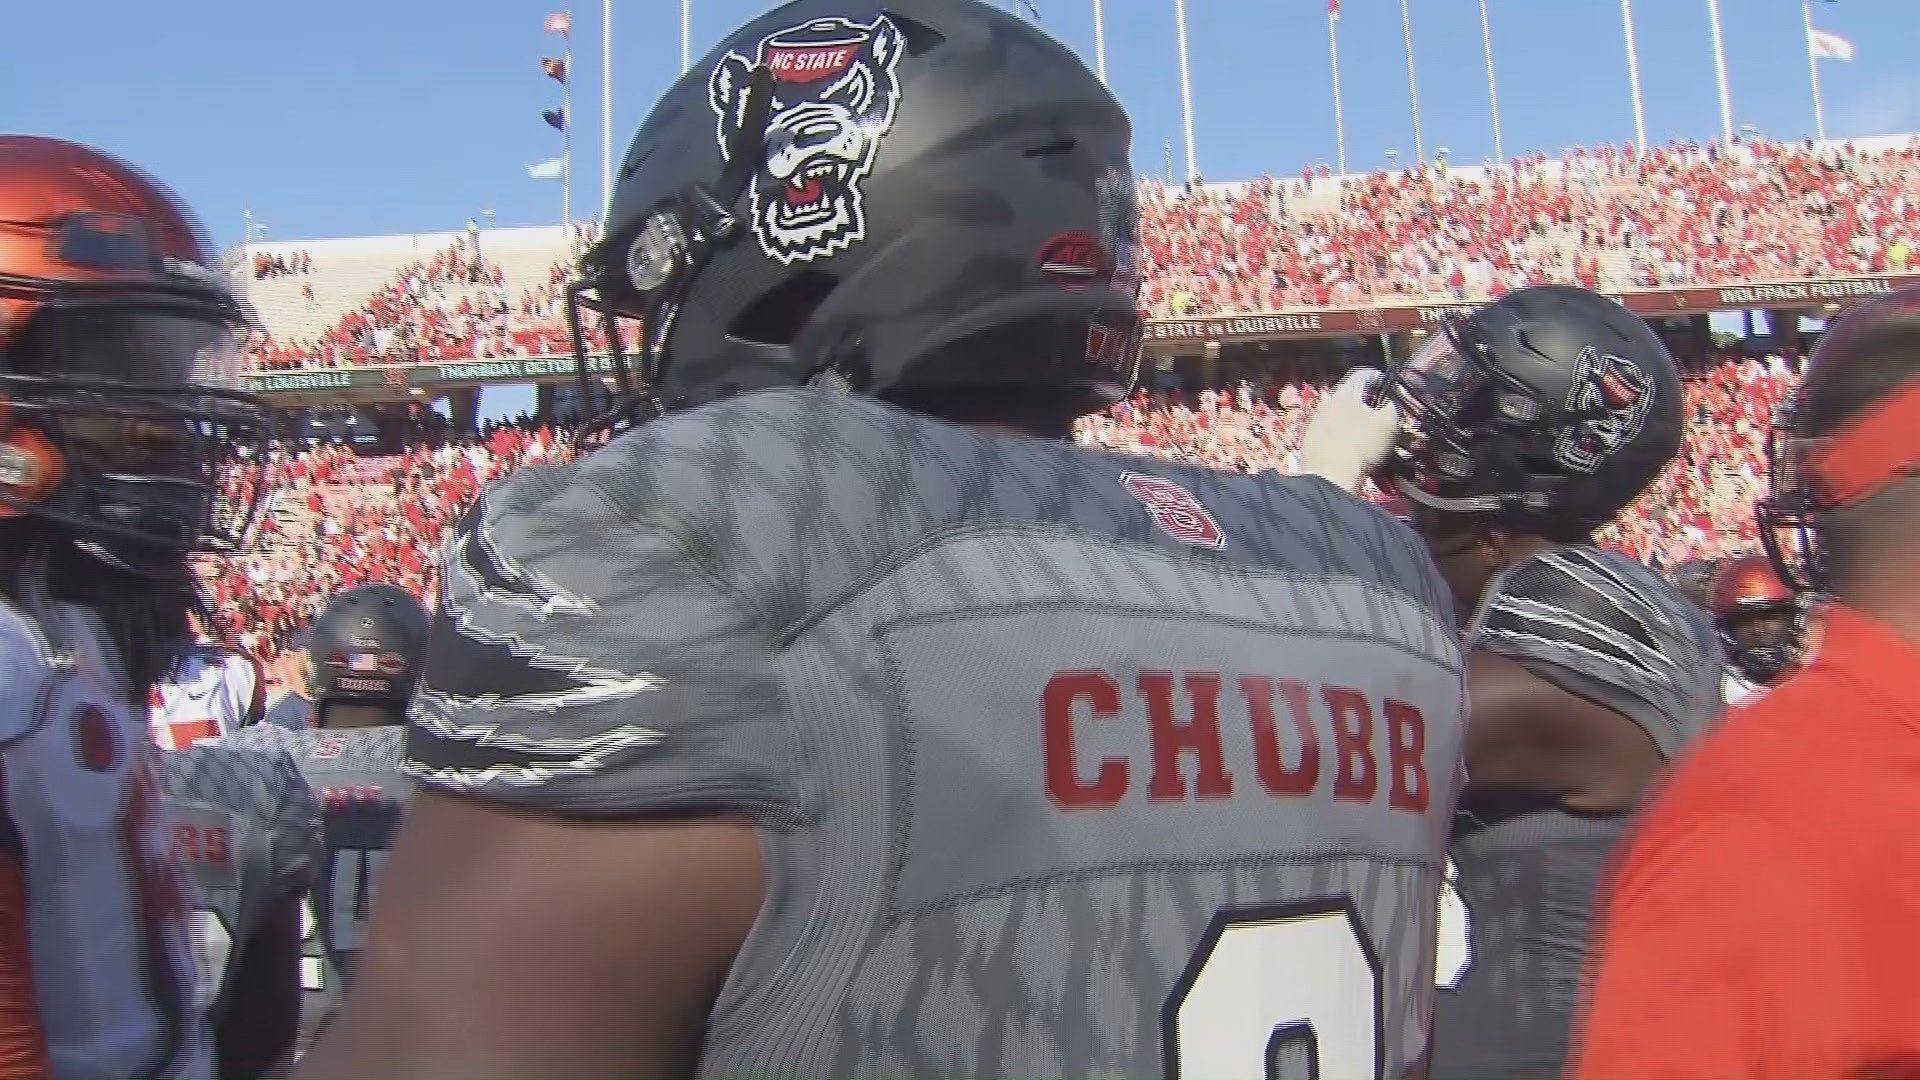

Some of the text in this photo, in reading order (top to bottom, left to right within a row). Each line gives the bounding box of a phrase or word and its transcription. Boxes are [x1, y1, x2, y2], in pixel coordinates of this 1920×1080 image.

[770, 49, 846, 70] NC STATE
[1719, 278, 1895, 303] WOLFPACK FOOTBALL
[1154, 321, 1204, 339] STATE
[1225, 313, 1322, 333] LOUISVILLE
[438, 361, 523, 379] THURSDAY,
[524, 356, 599, 374] OCTOBR
[265, 371, 352, 391] LOUISVILLE
[1040, 669, 1430, 813] CHUBB
